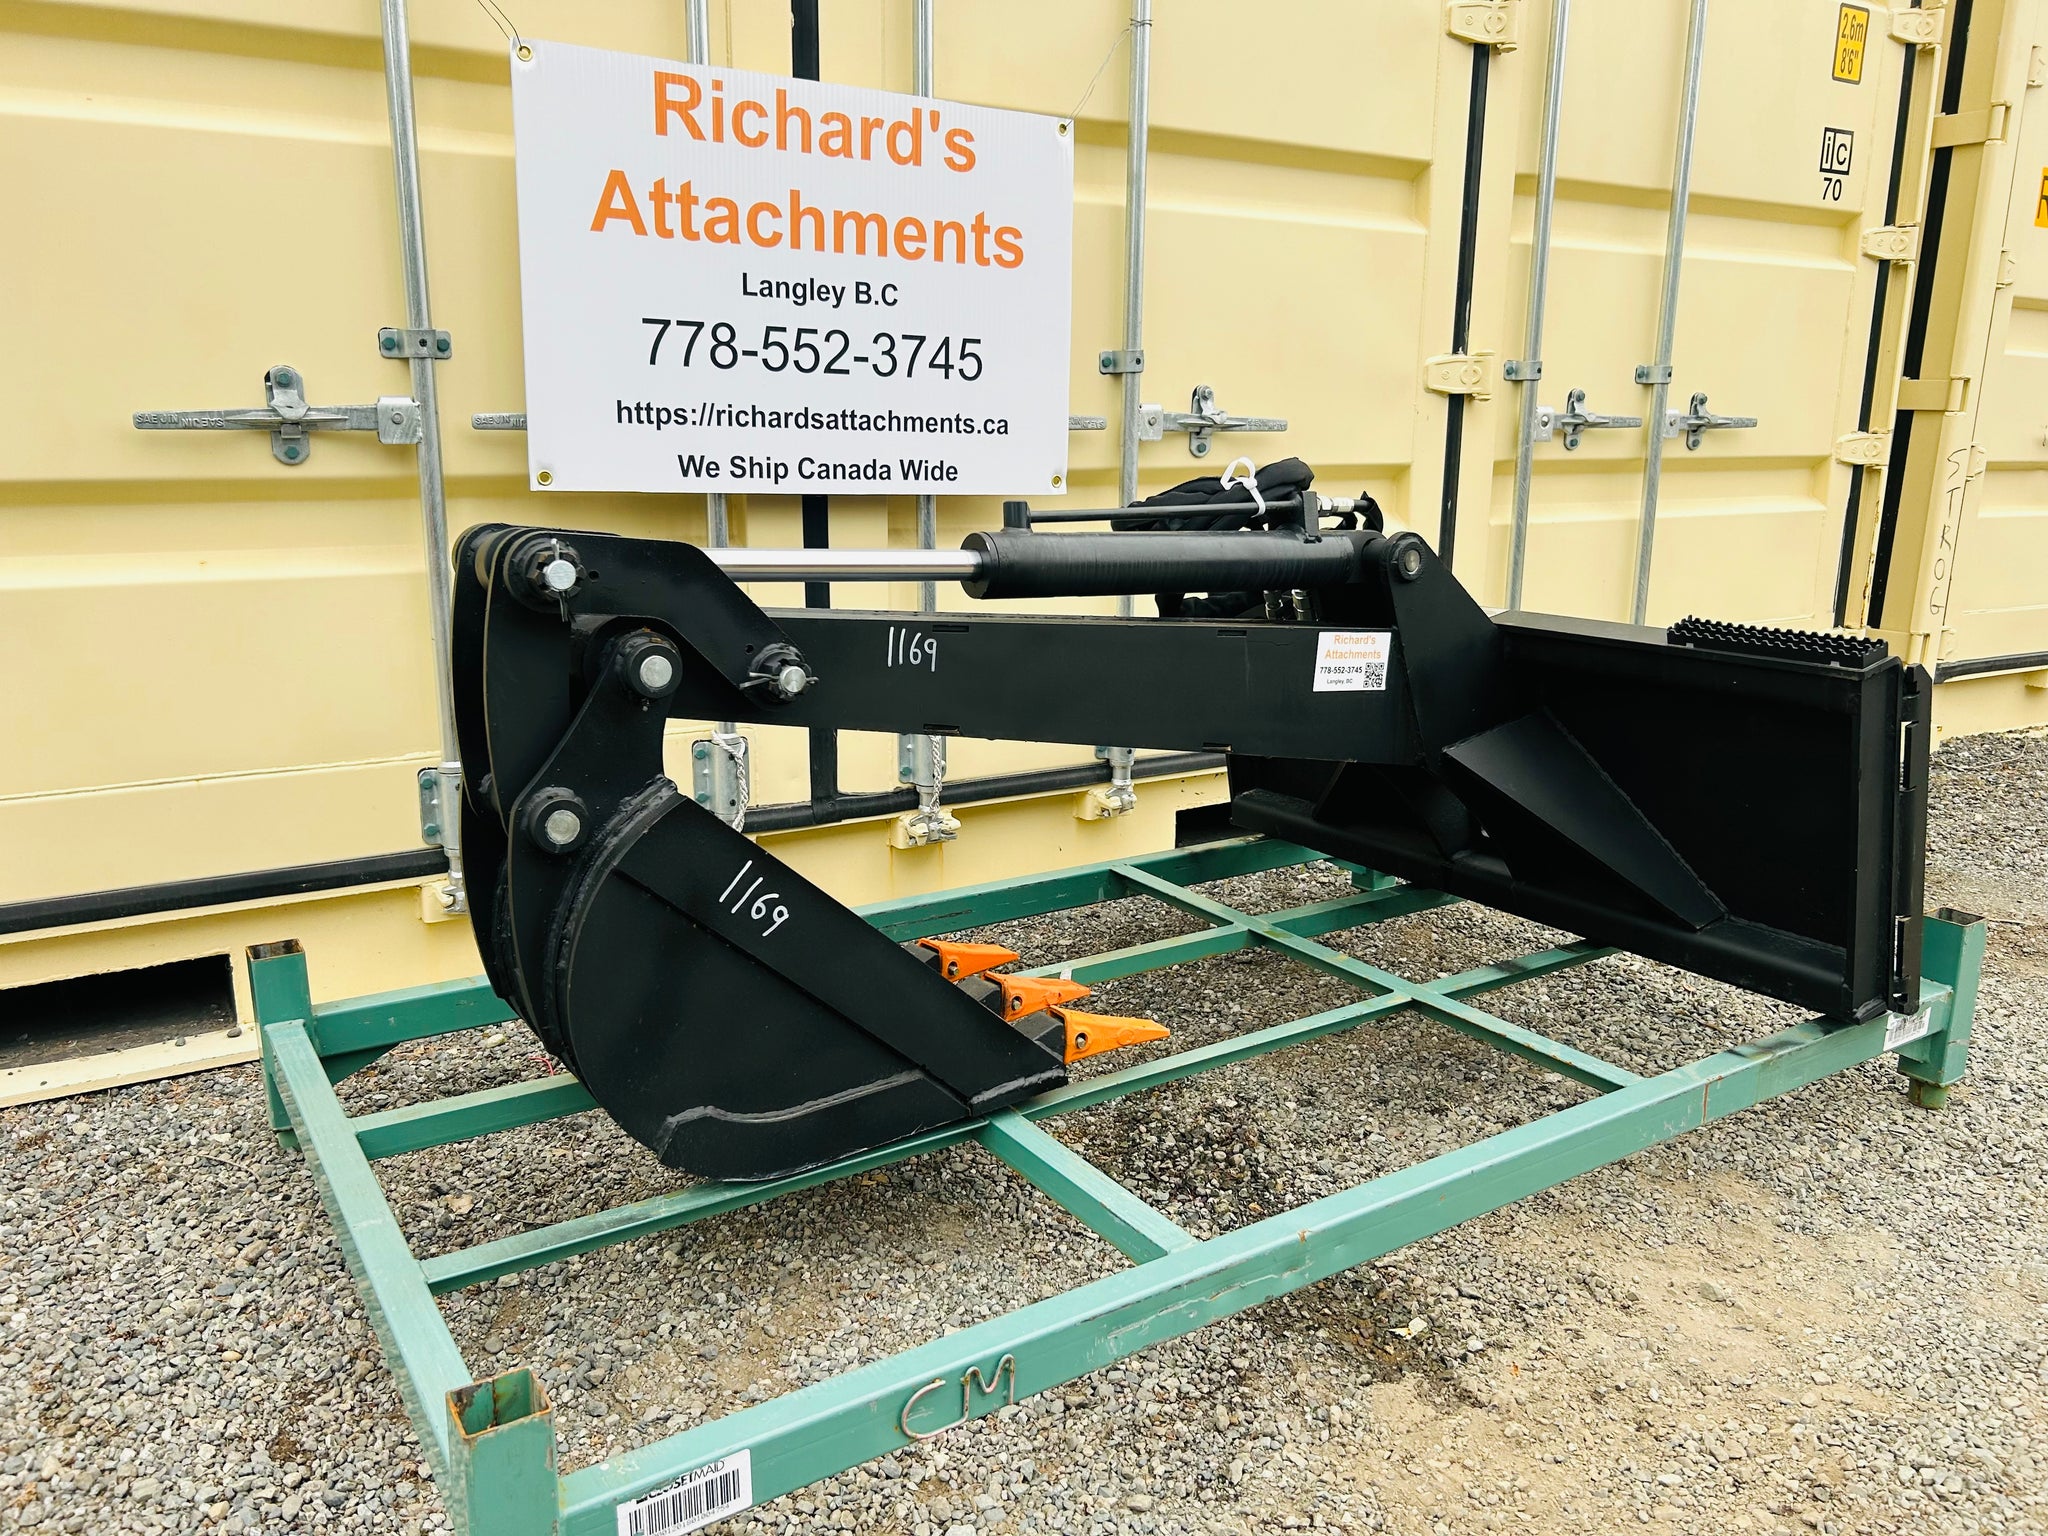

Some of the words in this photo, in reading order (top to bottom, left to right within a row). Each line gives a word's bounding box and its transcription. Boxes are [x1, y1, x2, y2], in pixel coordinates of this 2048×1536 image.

[654, 71, 977, 173] Richard's
[1822, 176, 1843, 202] 70
[590, 169, 1025, 269] Attachments
[742, 273, 846, 308] Langley
[855, 282, 898, 307] B.C
[641, 317, 983, 382] 778-552-3745
[616, 399, 1009, 435] https://richardsattachments.ca
[678, 455, 720, 479] We
[729, 456, 789, 485] Ship
[797, 457, 892, 481] Canada
[899, 459, 958, 482] Wide
[887, 626, 938, 672] 1169
[1325, 649, 1382, 660] Attachments
[1333, 634, 1376, 645] Richard's
[1319, 666, 1363, 675] 778-552-3745
[719, 860, 789, 937] 1169
